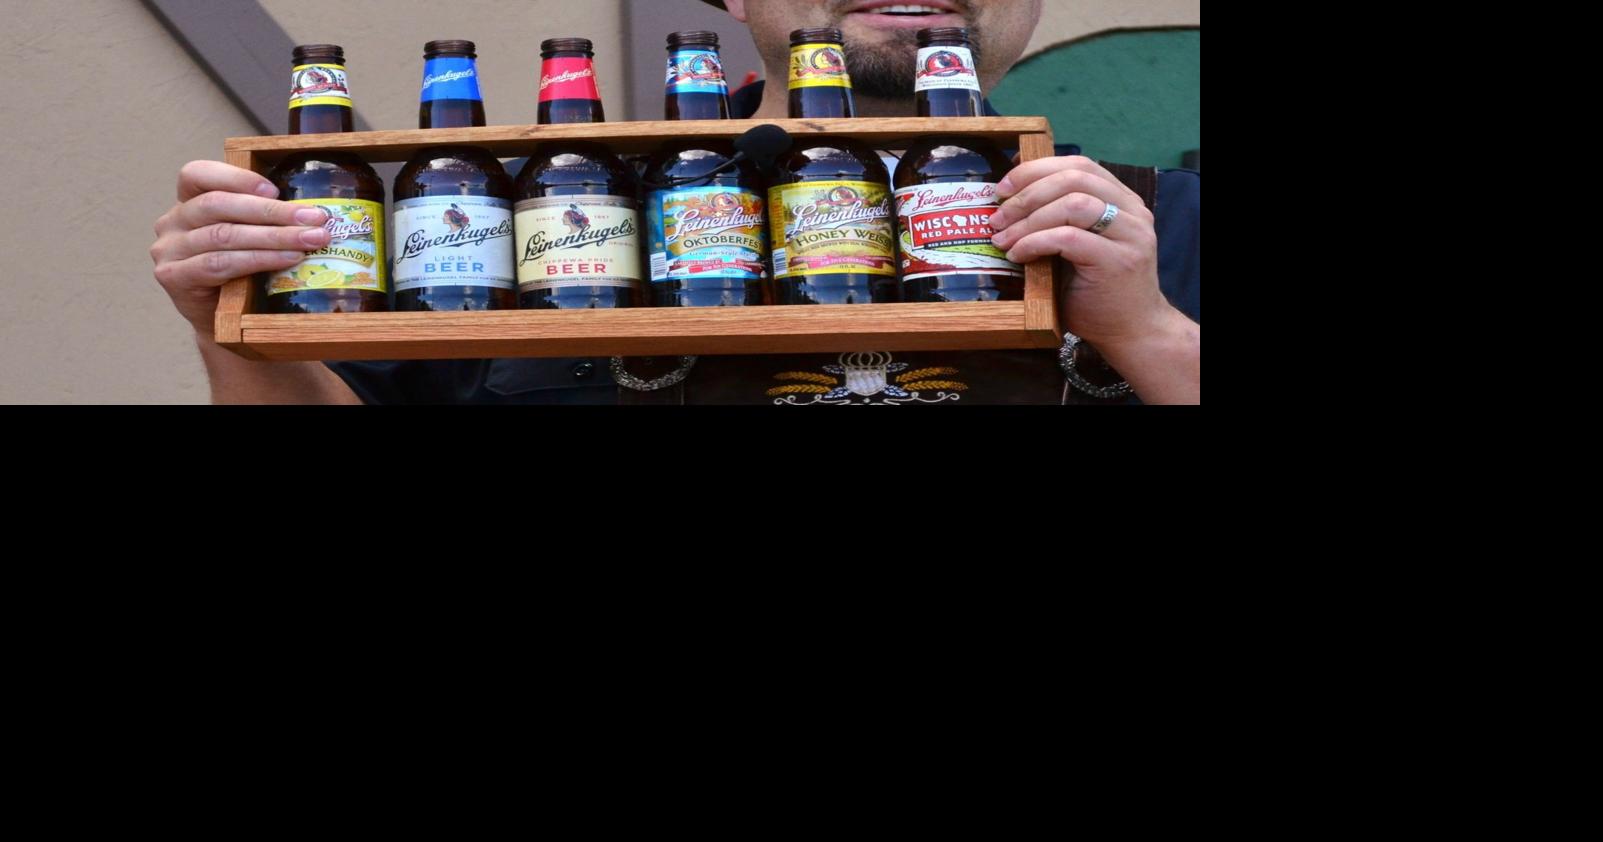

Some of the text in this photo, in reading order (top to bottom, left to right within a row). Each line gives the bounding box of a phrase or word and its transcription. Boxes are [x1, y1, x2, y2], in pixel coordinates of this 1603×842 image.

[324, 215, 373, 239] kugel's
[914, 214, 990, 232] WISCONS
[946, 228, 976, 236] PALE
[979, 227, 992, 235] AL
[396, 218, 513, 265] Leinenkugel's
[519, 217, 636, 267] Leinenkugel's
[795, 229, 850, 247] HONEY
[320, 246, 371, 264] SHANDY
[424, 262, 484, 273] BEER
[546, 263, 607, 275] BEER
